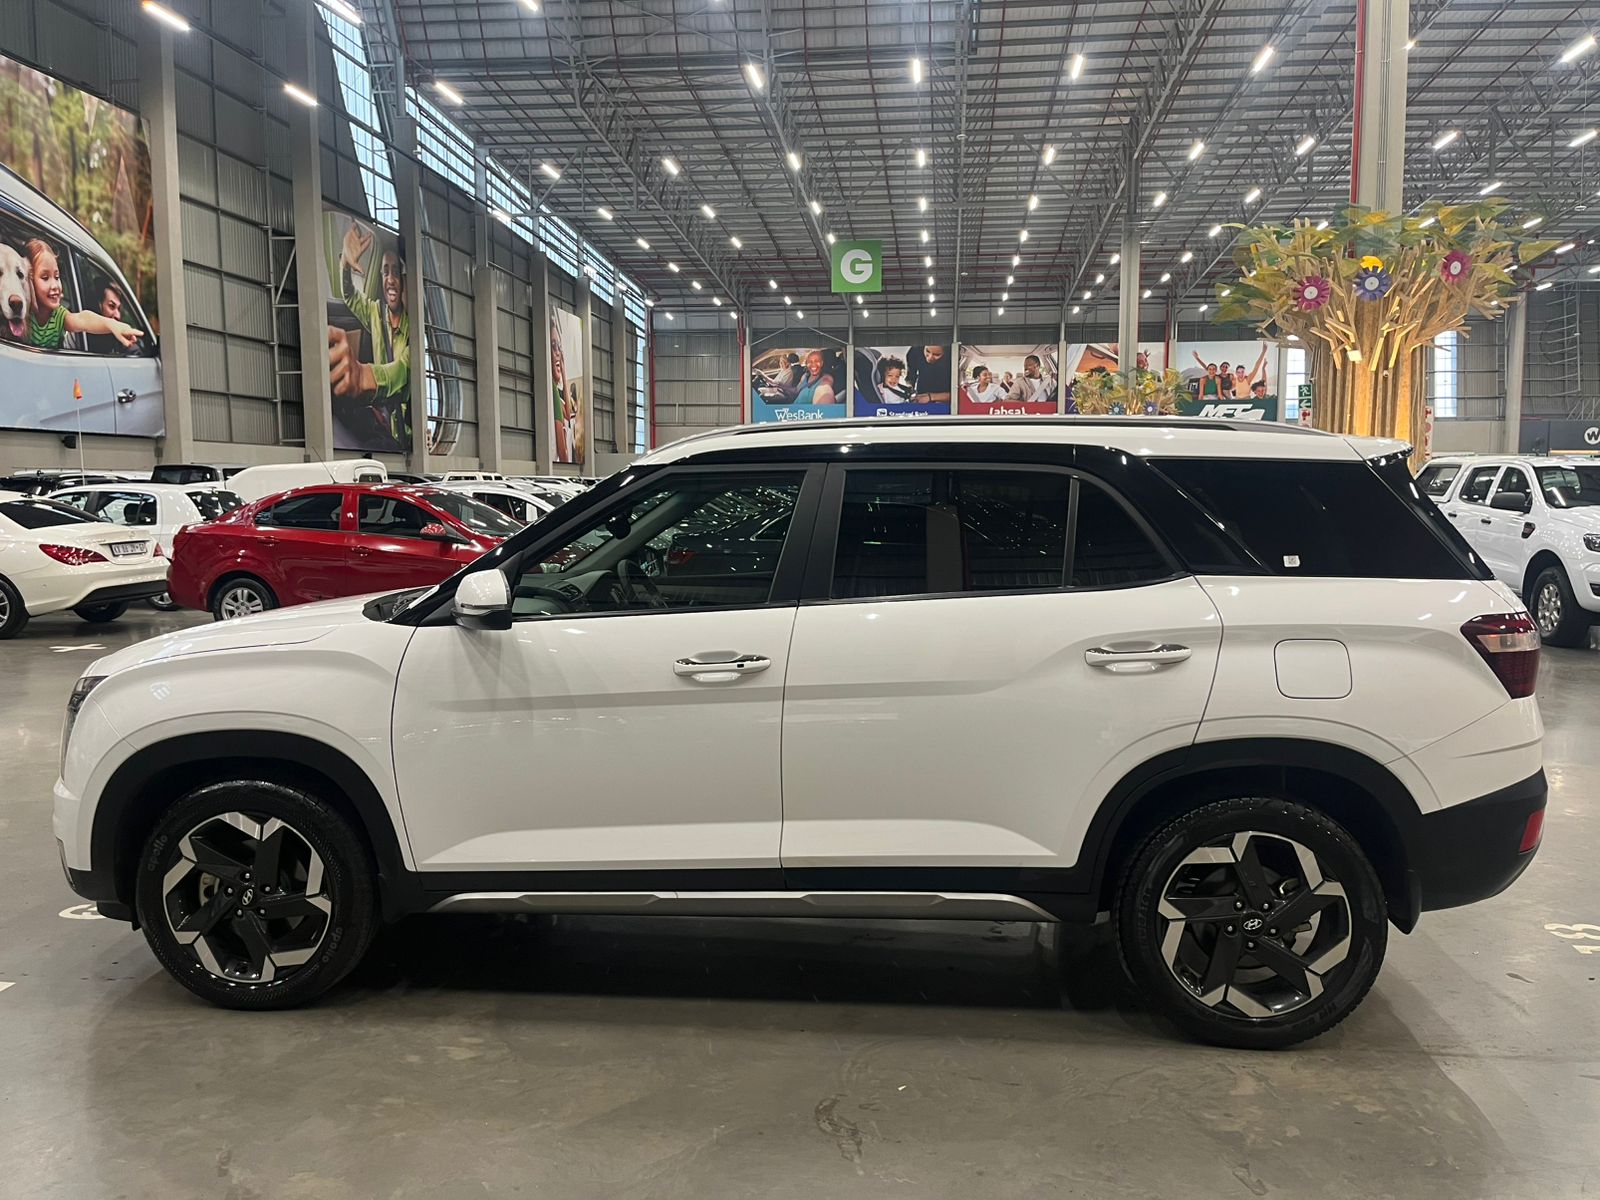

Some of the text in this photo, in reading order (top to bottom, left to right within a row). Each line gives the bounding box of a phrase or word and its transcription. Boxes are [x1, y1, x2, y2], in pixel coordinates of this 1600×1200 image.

[840, 248, 873, 284] G
[774, 408, 824, 422] WesBank
[147, 835, 168, 872] apollo
[322, 927, 343, 963] apollo
